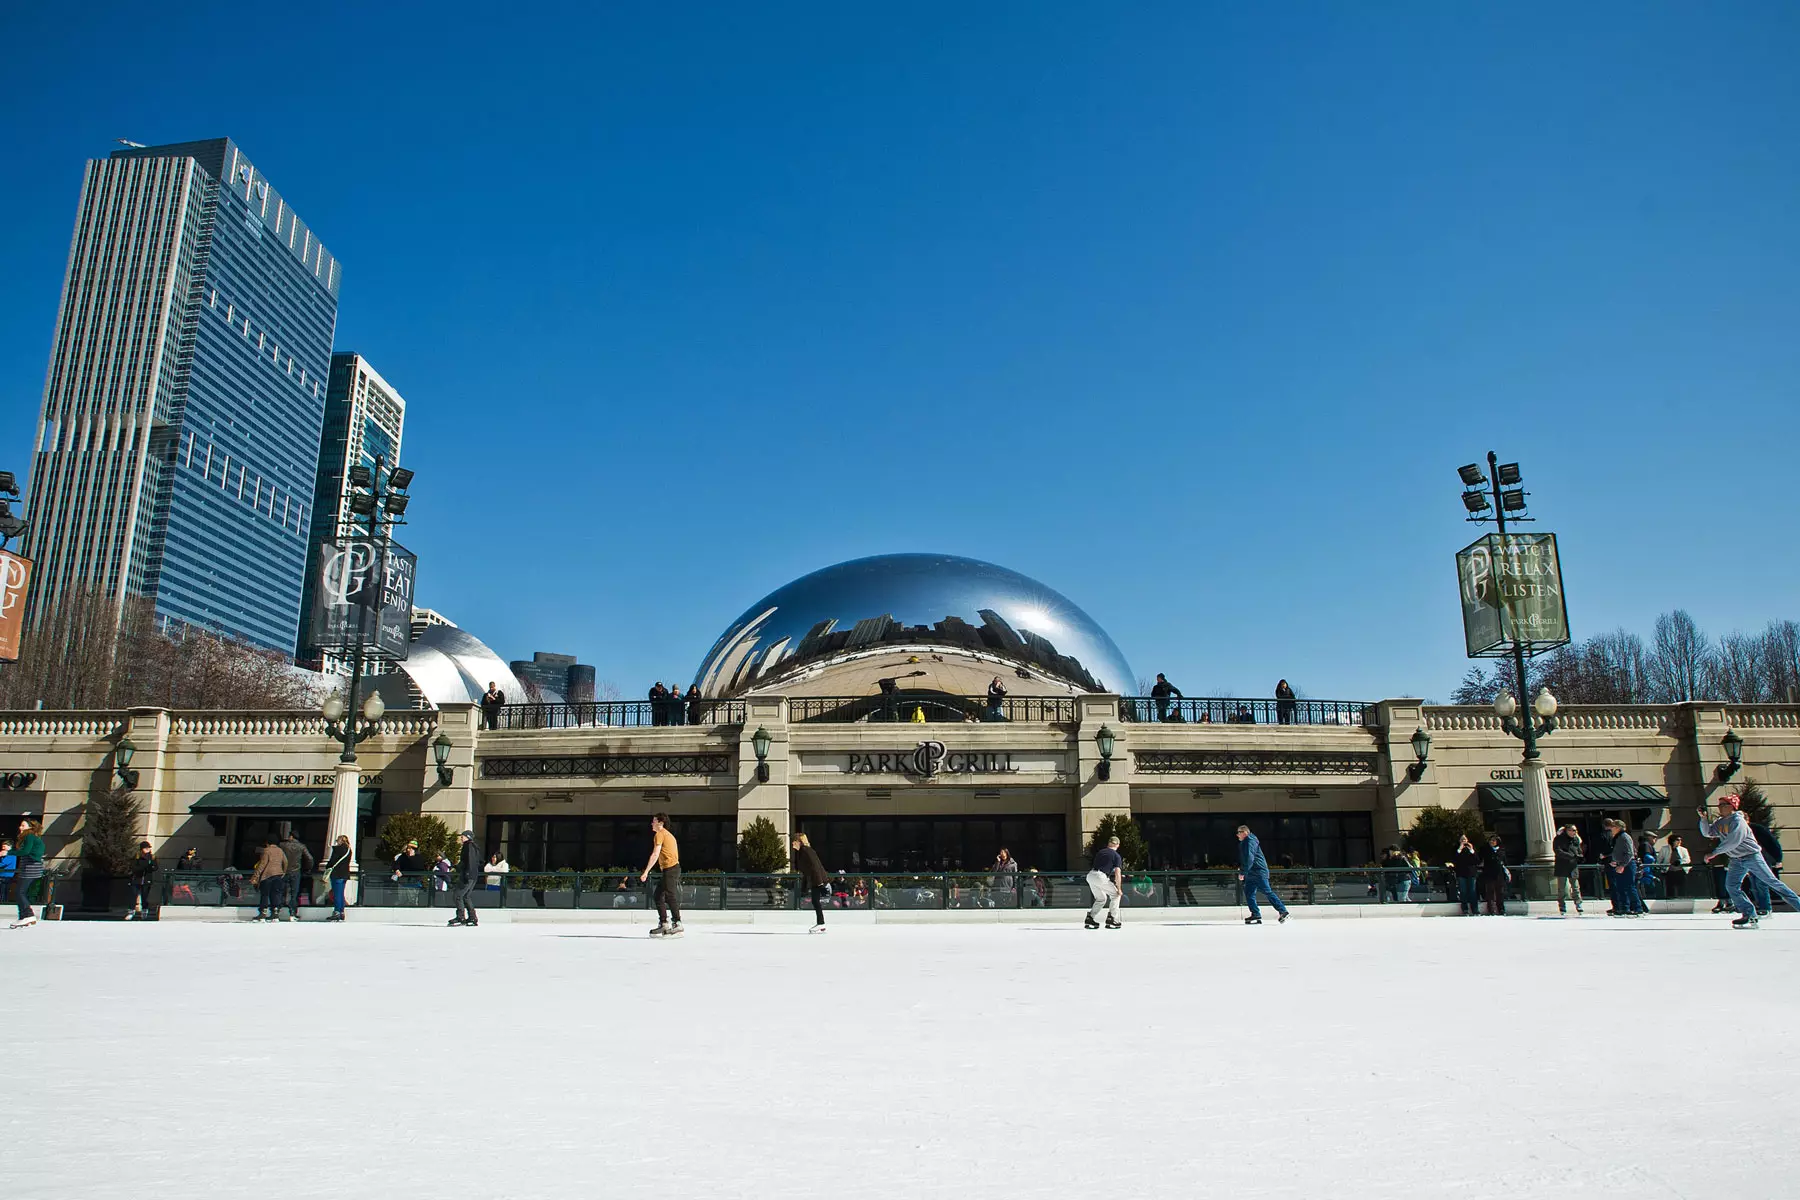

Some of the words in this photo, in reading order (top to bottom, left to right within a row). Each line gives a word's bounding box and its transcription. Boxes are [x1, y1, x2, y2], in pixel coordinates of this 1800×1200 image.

[1498, 544, 1553, 556] WATCH
[1500, 562, 1556, 576] RELAX
[1504, 584, 1559, 597] LISTEN
[383, 590, 407, 612] ENJO
[848, 753, 910, 772] PARK
[947, 752, 1020, 773] GRILL
[219, 774, 265, 785] RENTAL
[273, 774, 305, 785] SHOP
[312, 774, 384, 785] RESOMS
[1545, 768, 1564, 779] AFE
[1571, 768, 1623, 779] PARKING
